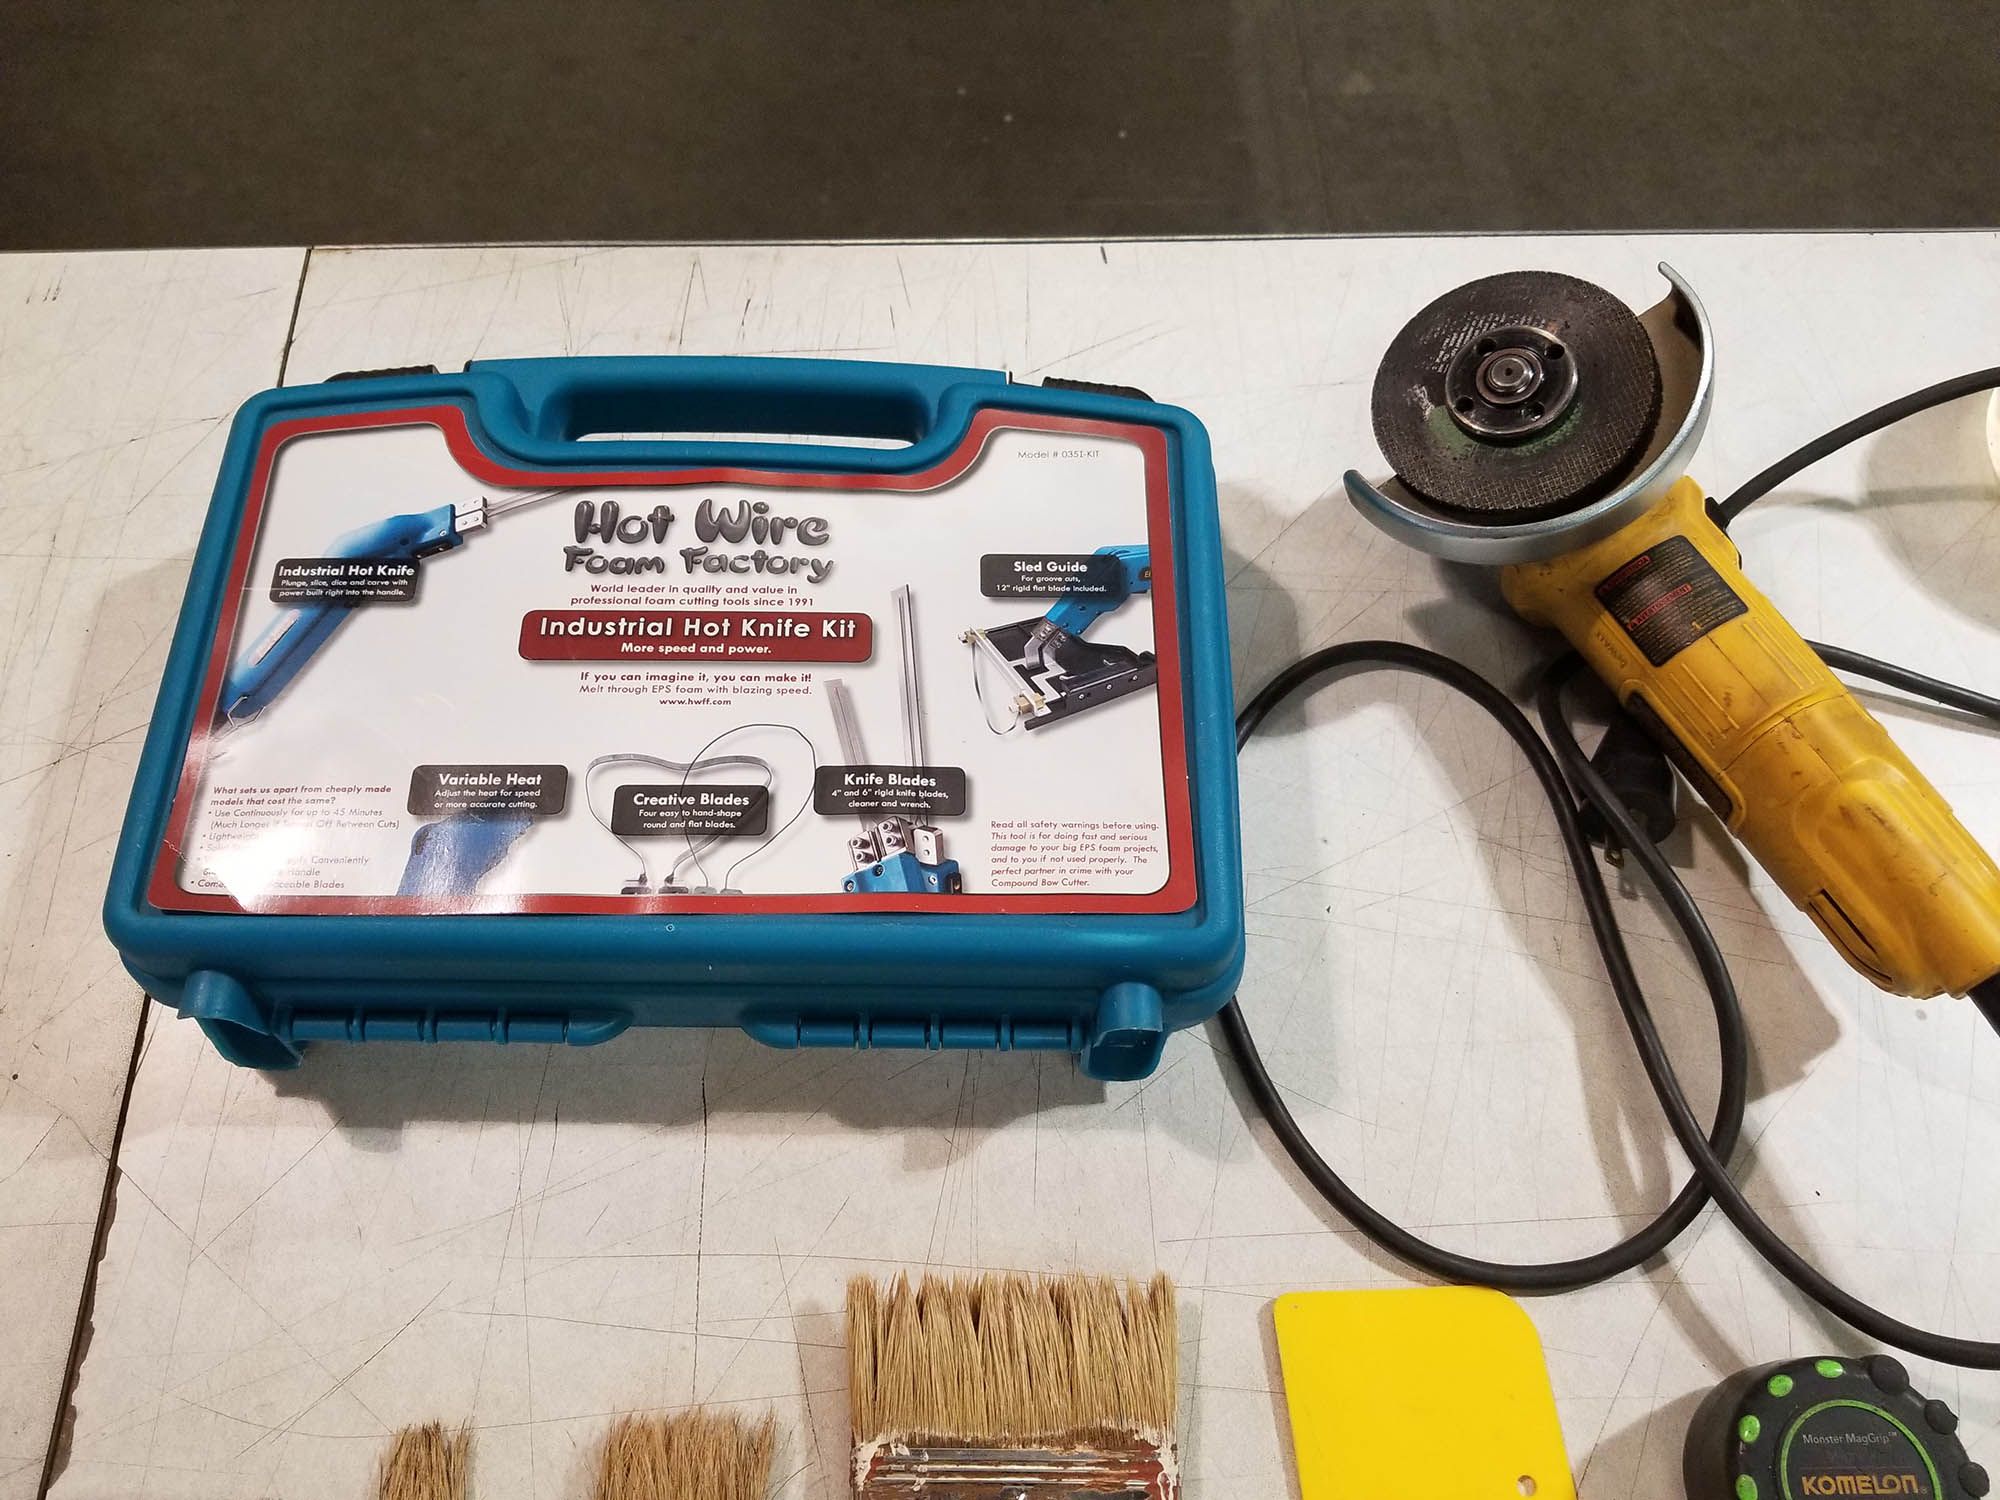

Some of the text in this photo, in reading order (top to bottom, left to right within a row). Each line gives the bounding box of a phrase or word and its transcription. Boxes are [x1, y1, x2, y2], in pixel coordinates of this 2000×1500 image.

[574, 499, 830, 545] Hot Wire
[563, 547, 833, 583] Foam Factory
[1014, 562, 1087, 572] Sled Guide
[279, 565, 415, 576] Industrial Hot Knife
[325, 589, 343, 597] right
[591, 584, 797, 596] World leader in quality and value in
[571, 596, 814, 608] professional foam cutting tools since 1991
[541, 617, 856, 638] Industrial Hot Knife Kit
[621, 642, 771, 656] More speed and power.
[581, 672, 811, 685] If you can imagine it, you can make it!
[579, 685, 812, 697] Melt through EPS foam with blazing speed.
[659, 698, 731, 706] www.hwff.com
[439, 774, 542, 785] Variable Heat
[845, 774, 936, 786] Knife Blades
[274, 786, 298, 795] apart
[326, 786, 362, 795] cheaply
[434, 789, 461, 798] Adjust
[515, 789, 540, 798] speed
[875, 789, 893, 798] rigid
[919, 790, 949, 799] blades,
[634, 793, 749, 805] Creative Blades
[508, 801, 537, 809] cutting.
[693, 810, 742, 818] hand-shape
[1031, 821, 1057, 829] safety
[1062, 822, 1099, 830] warnings
[1135, 823, 1159, 831] using.
[1054, 833, 1078, 841] doing
[991, 844, 1026, 852] damage
[1124, 845, 1158, 853] projects,
[1089, 856, 1127, 864] properly.
[992, 868, 1021, 876] perfect
[1024, 868, 1055, 876] partner
[992, 879, 1038, 888] Compound
[1802, 1434, 1844, 1444] Monster
[1802, 1475, 1918, 1495] KOMELON
